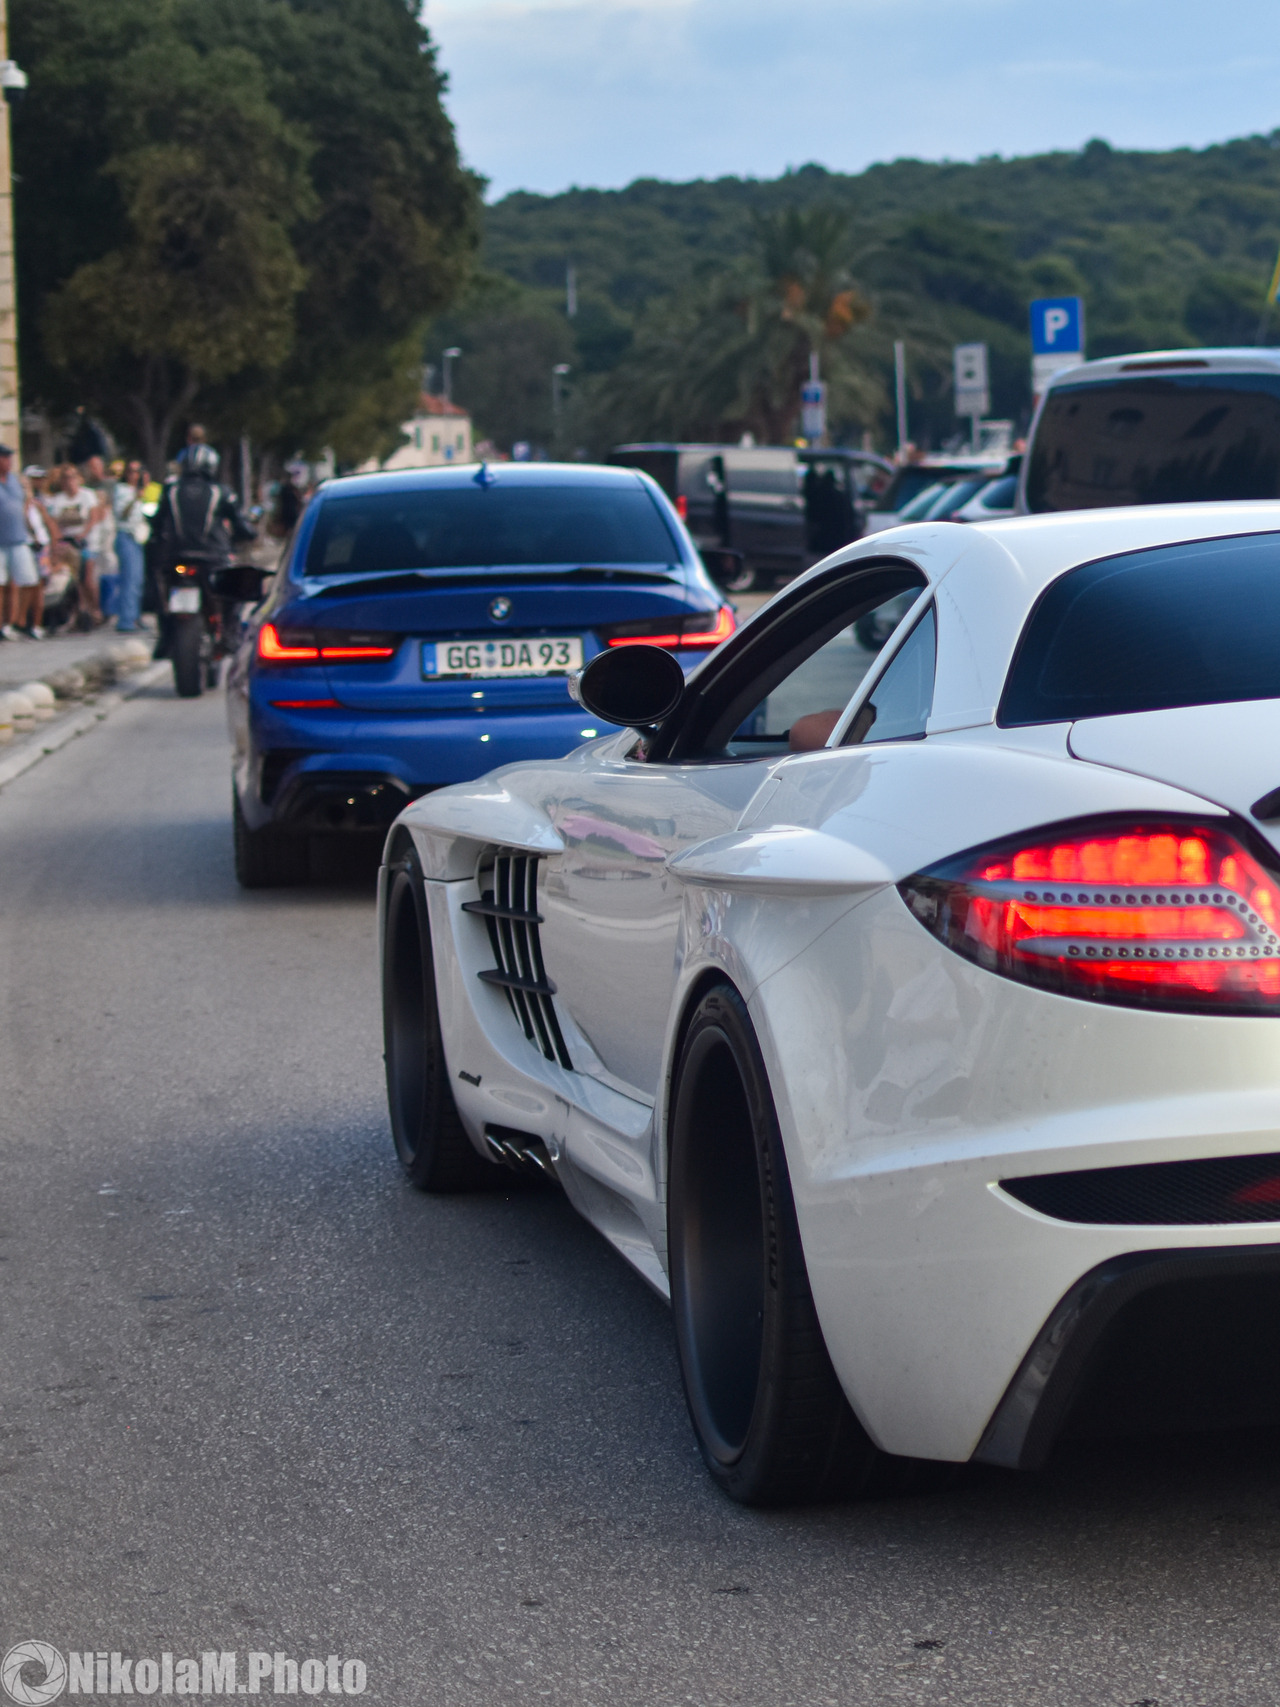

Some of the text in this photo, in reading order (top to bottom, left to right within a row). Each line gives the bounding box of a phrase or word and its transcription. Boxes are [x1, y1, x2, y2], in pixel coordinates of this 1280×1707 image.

[1045, 308, 1070, 345] P
[447, 645, 482, 669] GG
[500, 643, 533, 667] DA
[539, 642, 571, 665] 93
